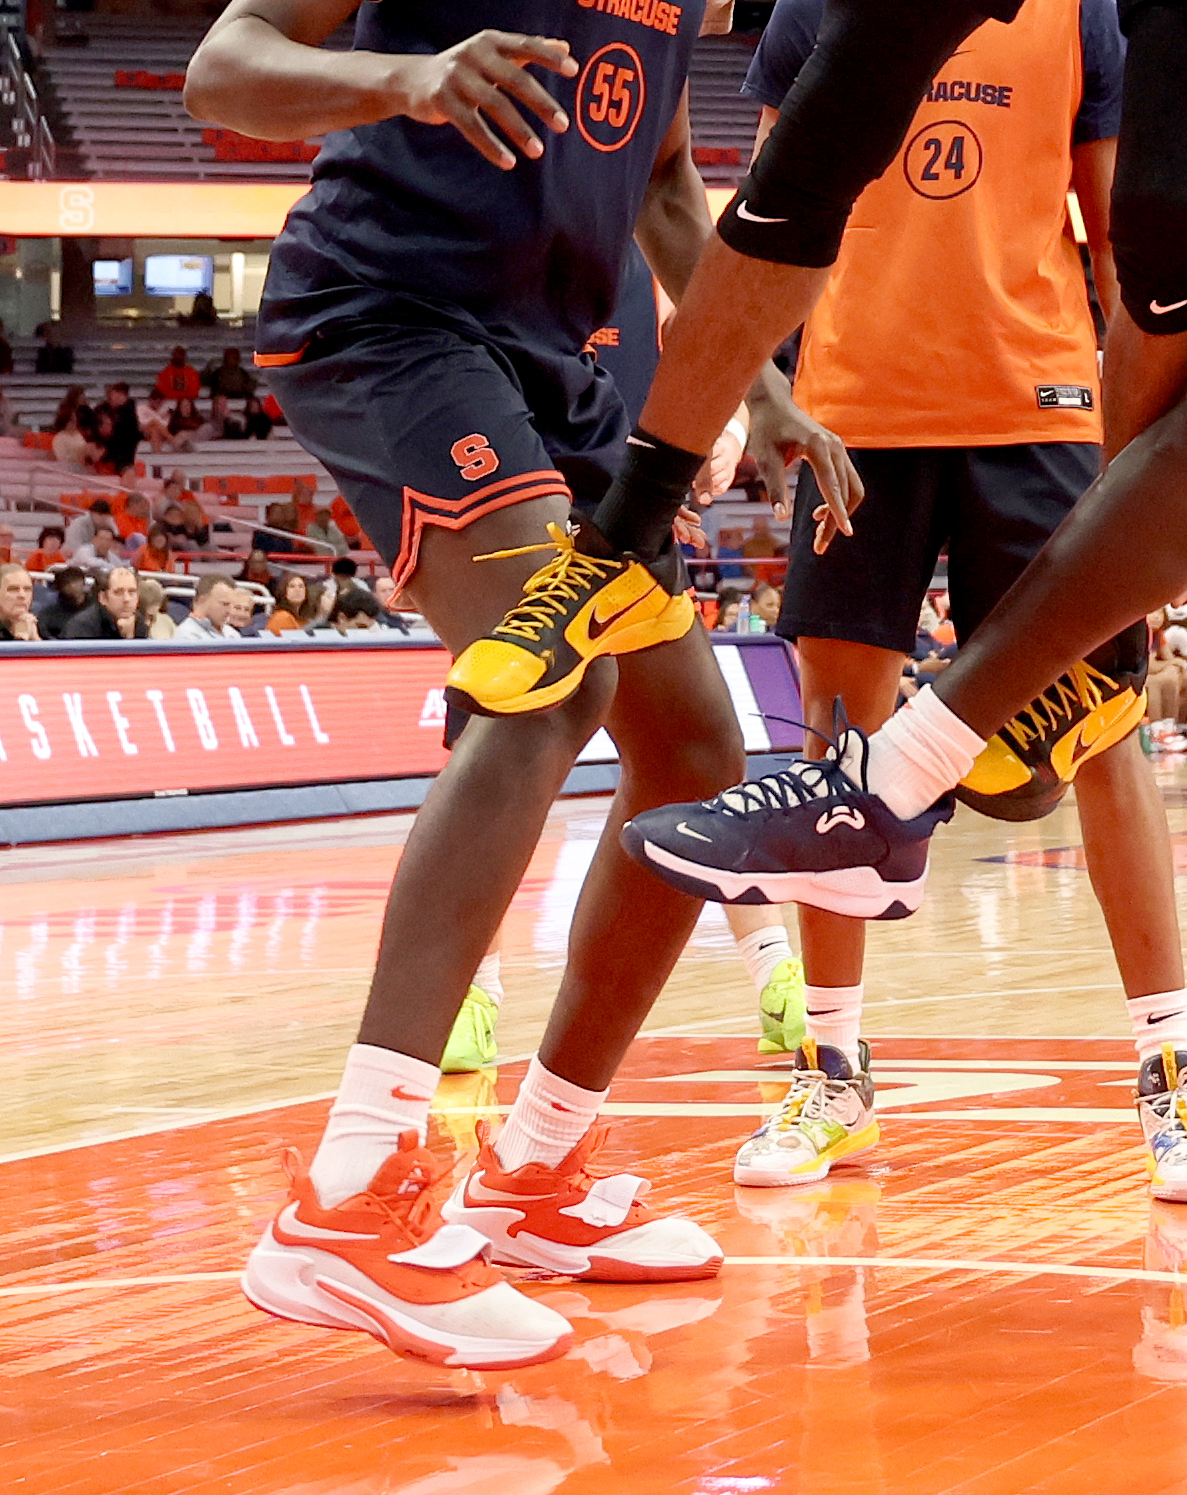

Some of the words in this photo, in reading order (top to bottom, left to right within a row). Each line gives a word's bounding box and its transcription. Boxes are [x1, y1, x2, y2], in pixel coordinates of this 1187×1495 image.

[588, 61, 636, 128] 55
[920, 135, 965, 181] 24
[449, 432, 500, 482] S
[0, 684, 330, 762] SKETBALL
